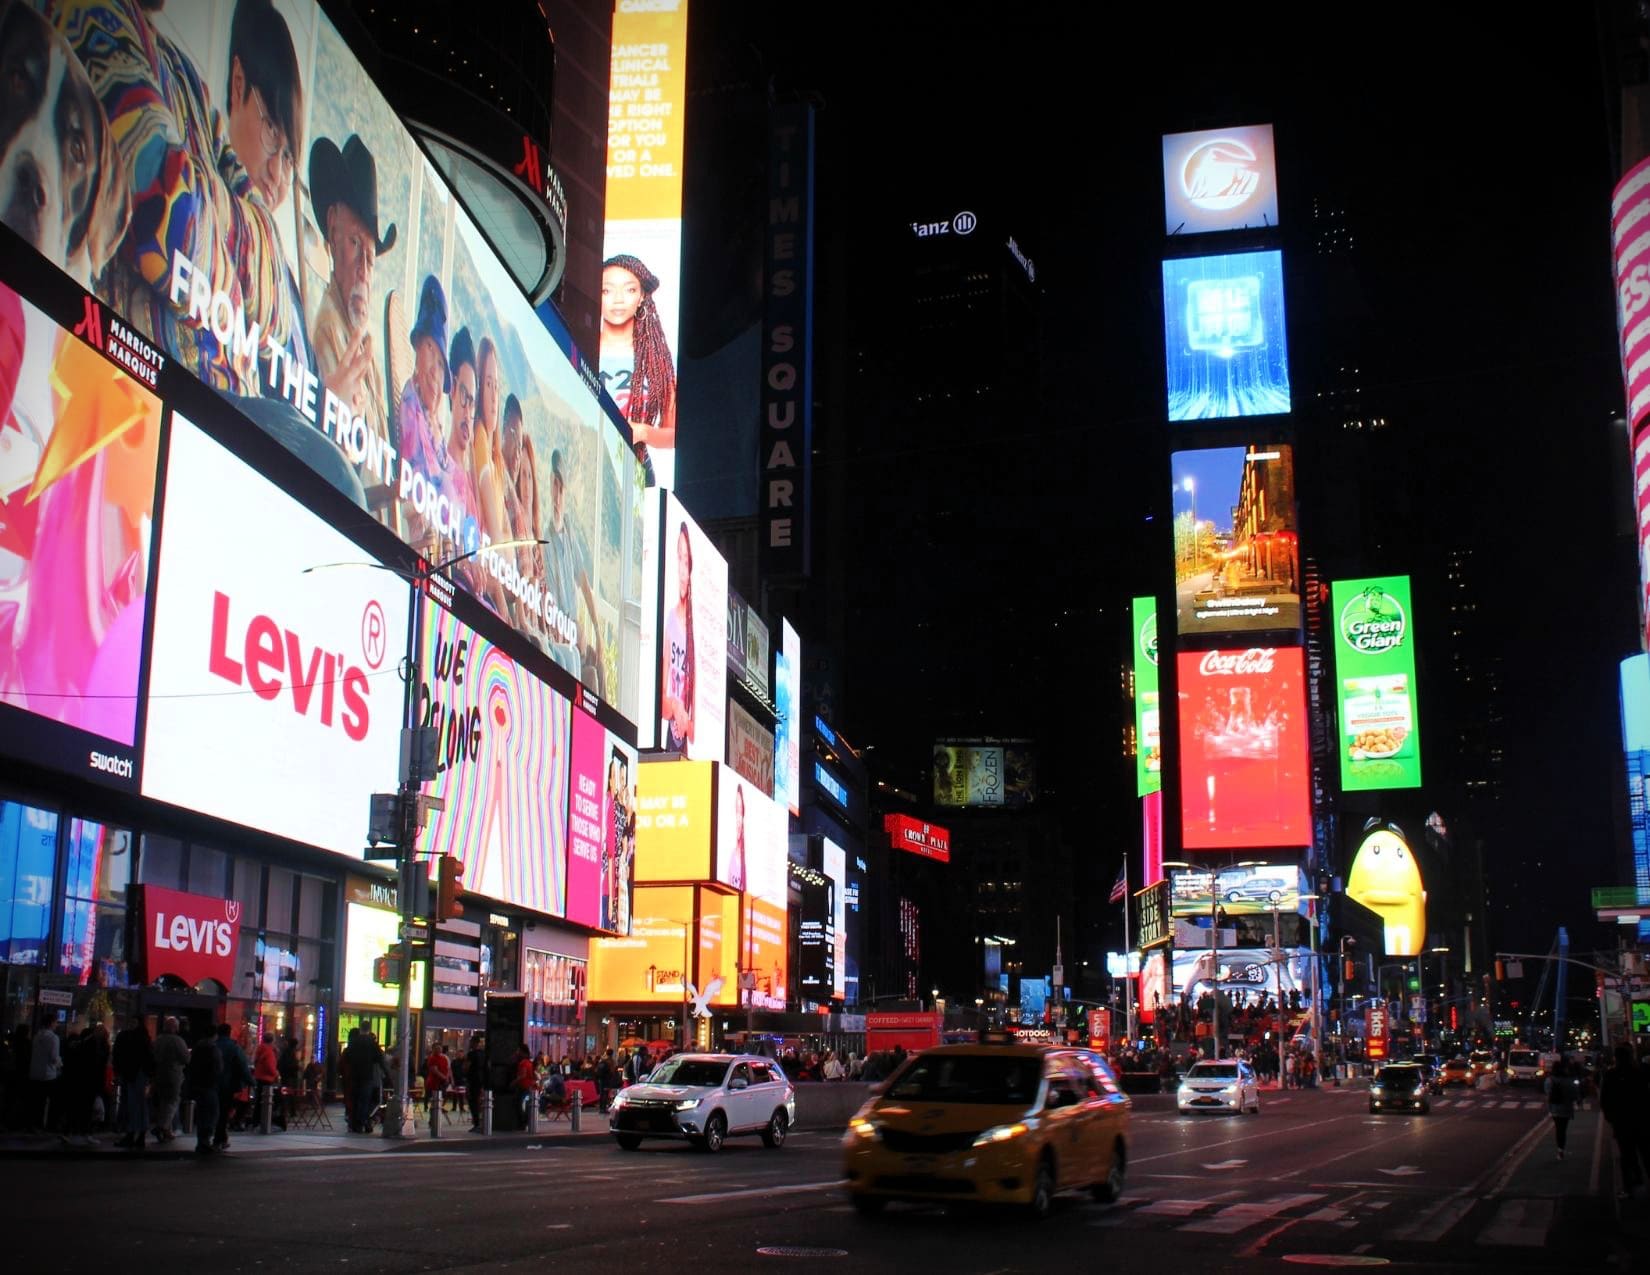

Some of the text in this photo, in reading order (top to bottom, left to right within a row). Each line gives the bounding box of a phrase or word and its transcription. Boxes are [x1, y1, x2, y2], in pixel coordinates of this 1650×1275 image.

[612, 44, 668, 57] ANCER
[612, 59, 671, 72] LINICAL
[607, 133, 666, 147] OR YOU
[110, 319, 164, 370] MARRIOTT
[767, 126, 800, 547] TIMES SQUARE
[108, 338, 158, 386] MARQUIS
[170, 248, 463, 546] FROM THE FRONT PORCH
[545, 592, 577, 651] Group
[1349, 620, 1402, 635] Green
[1356, 633, 1405, 650] Giant
[434, 631, 468, 686] WE
[89, 751, 132, 778] swatch
[983, 749, 999, 803] FROZEN
[370, 883, 398, 909] INVICT
[1142, 904, 1158, 926] SIDE
[1140, 921, 1161, 944] STORY
[1370, 1011, 1384, 1037] tkts
